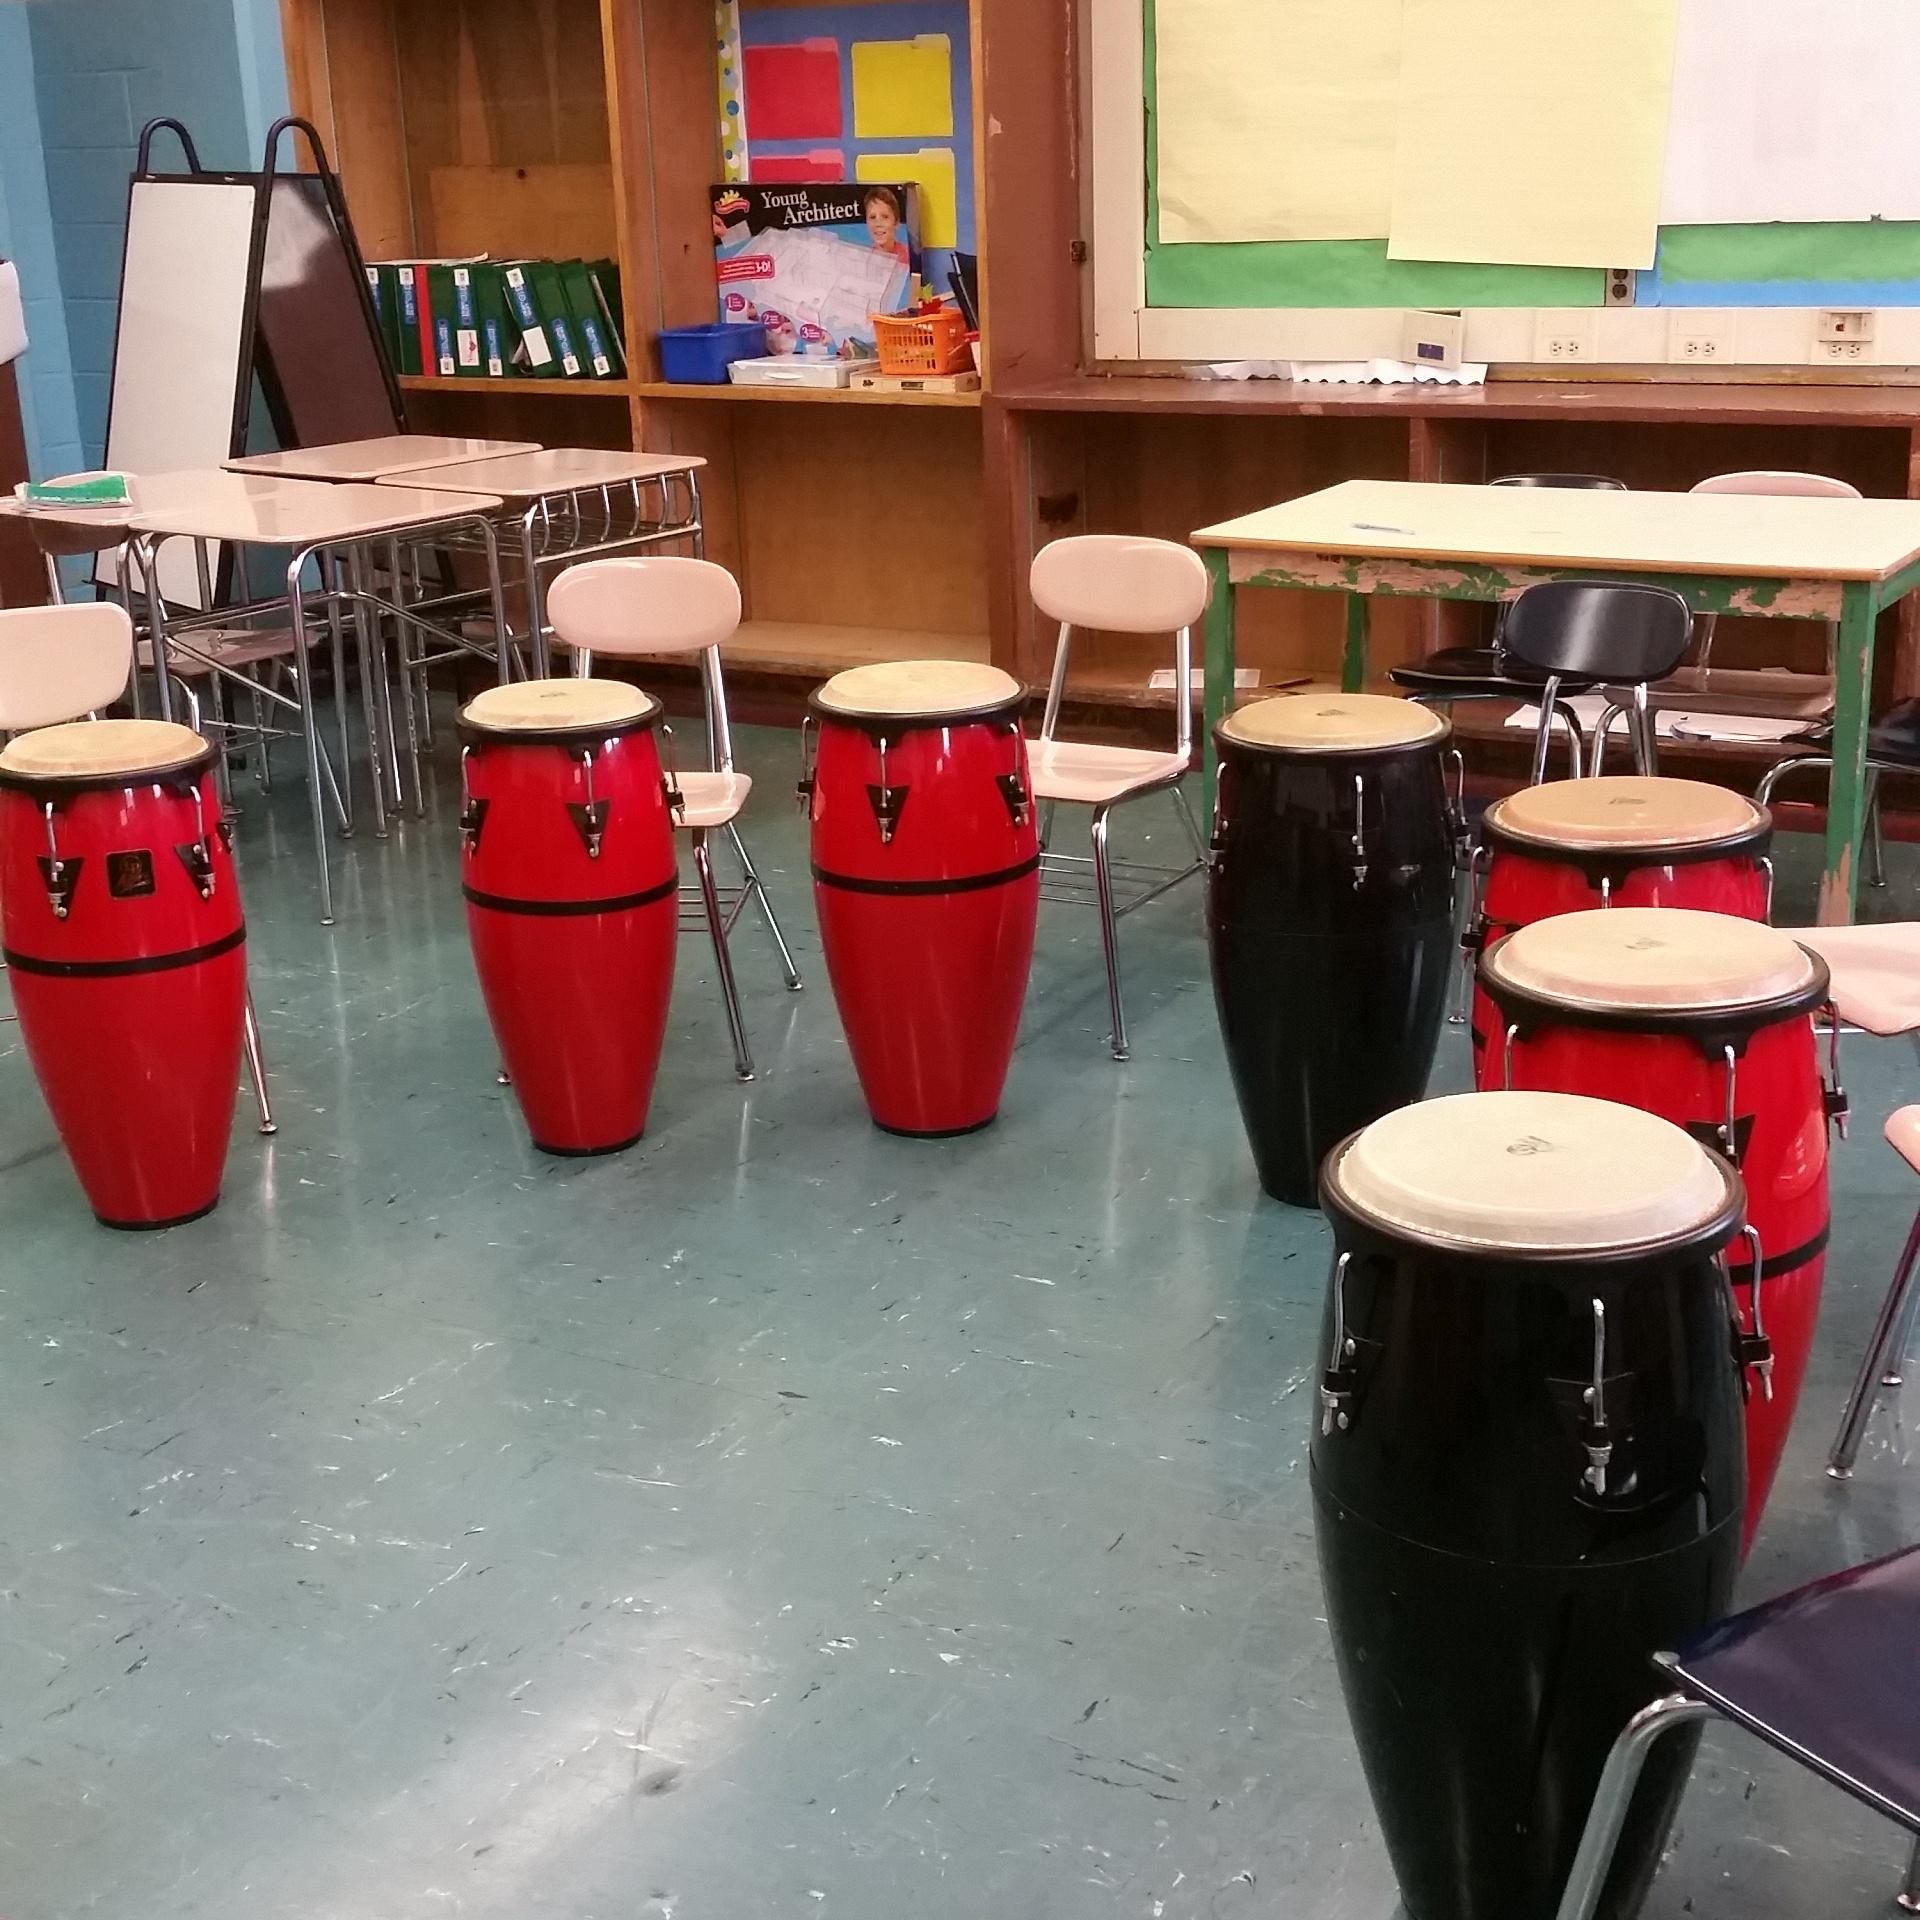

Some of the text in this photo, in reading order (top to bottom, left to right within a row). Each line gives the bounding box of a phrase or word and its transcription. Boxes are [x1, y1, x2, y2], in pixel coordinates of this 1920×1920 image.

[761, 191, 809, 209] Young
[783, 201, 861, 225] Architect
[801, 326, 809, 339] 3
